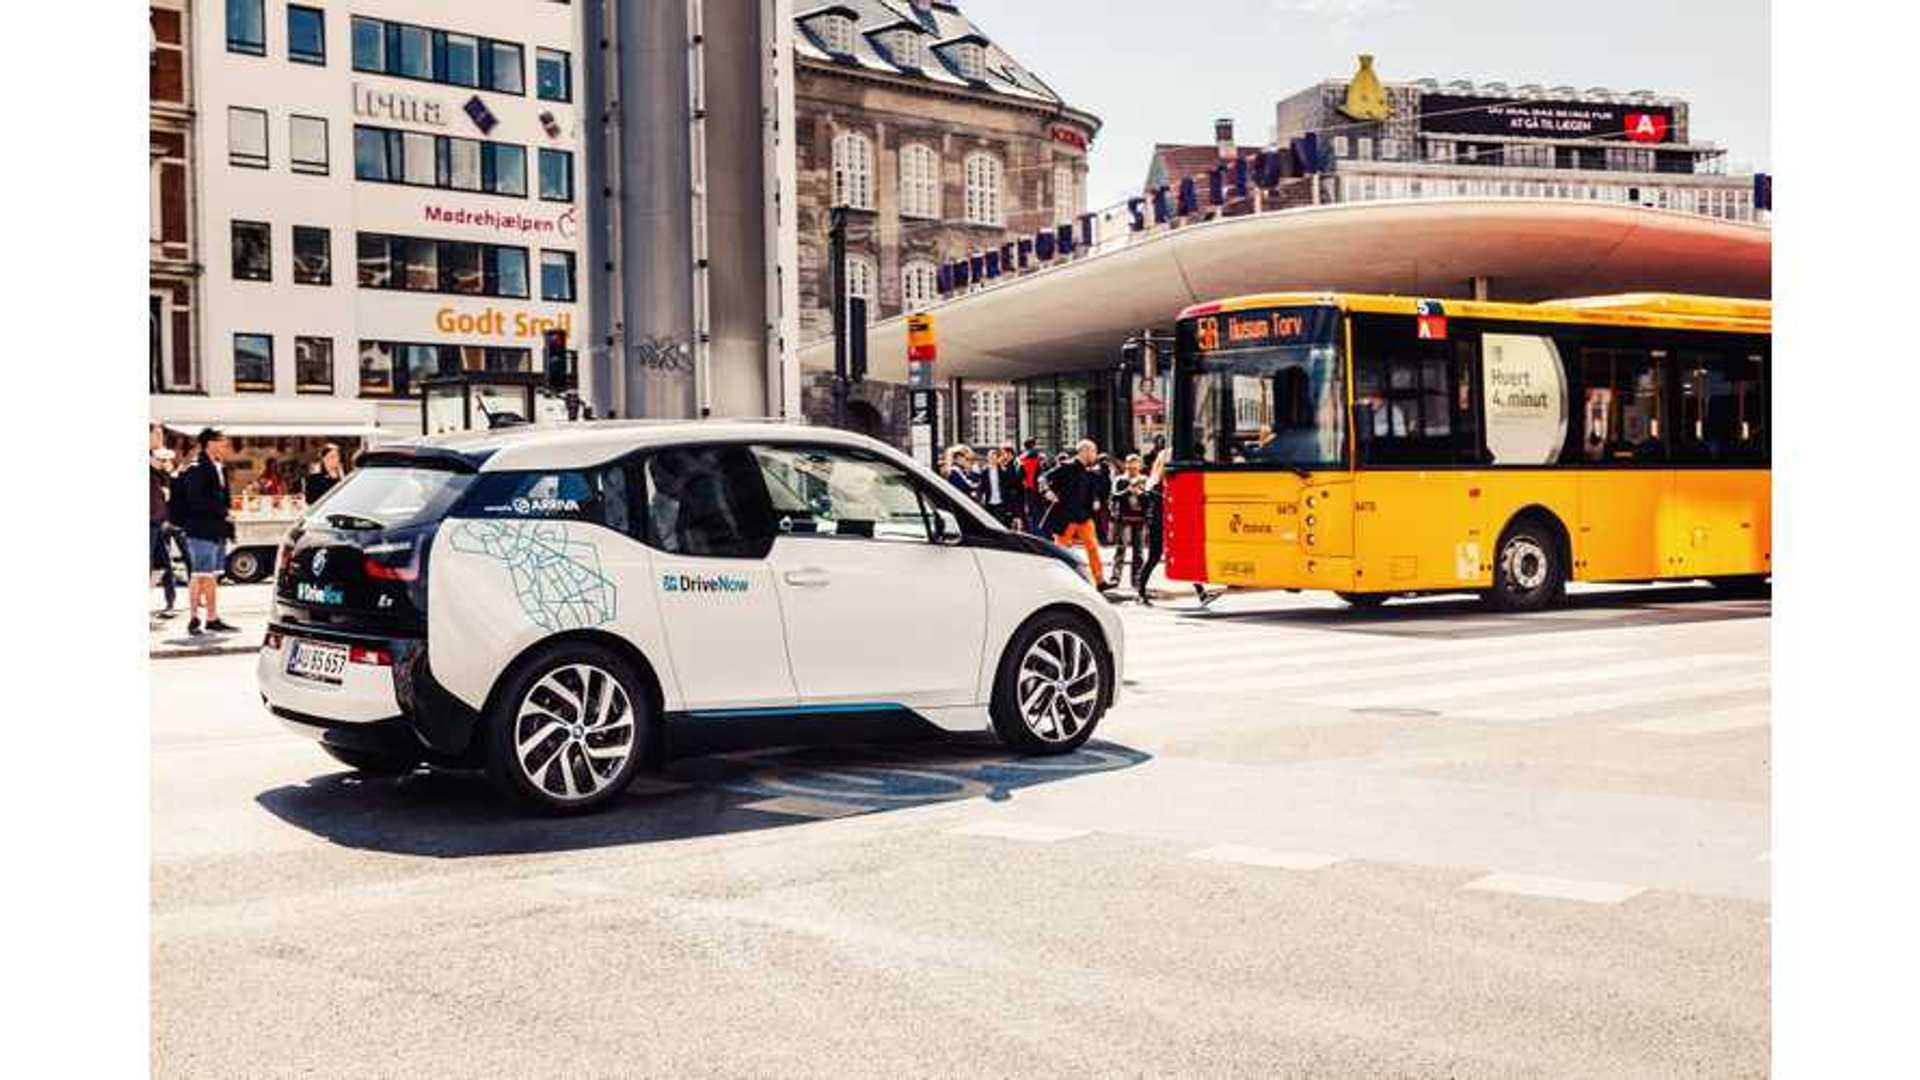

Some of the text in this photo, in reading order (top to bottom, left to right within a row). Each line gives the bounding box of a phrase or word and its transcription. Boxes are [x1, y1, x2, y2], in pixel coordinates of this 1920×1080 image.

[1637, 114, 1655, 134] A
[424, 205, 554, 232] Mødrehjælpen
[436, 307, 505, 337] Godt
[1273, 312, 1302, 337] Torv
[1507, 389, 1548, 409] minut
[531, 499, 582, 512] ARRIVA
[680, 575, 749, 592] DriveNow
